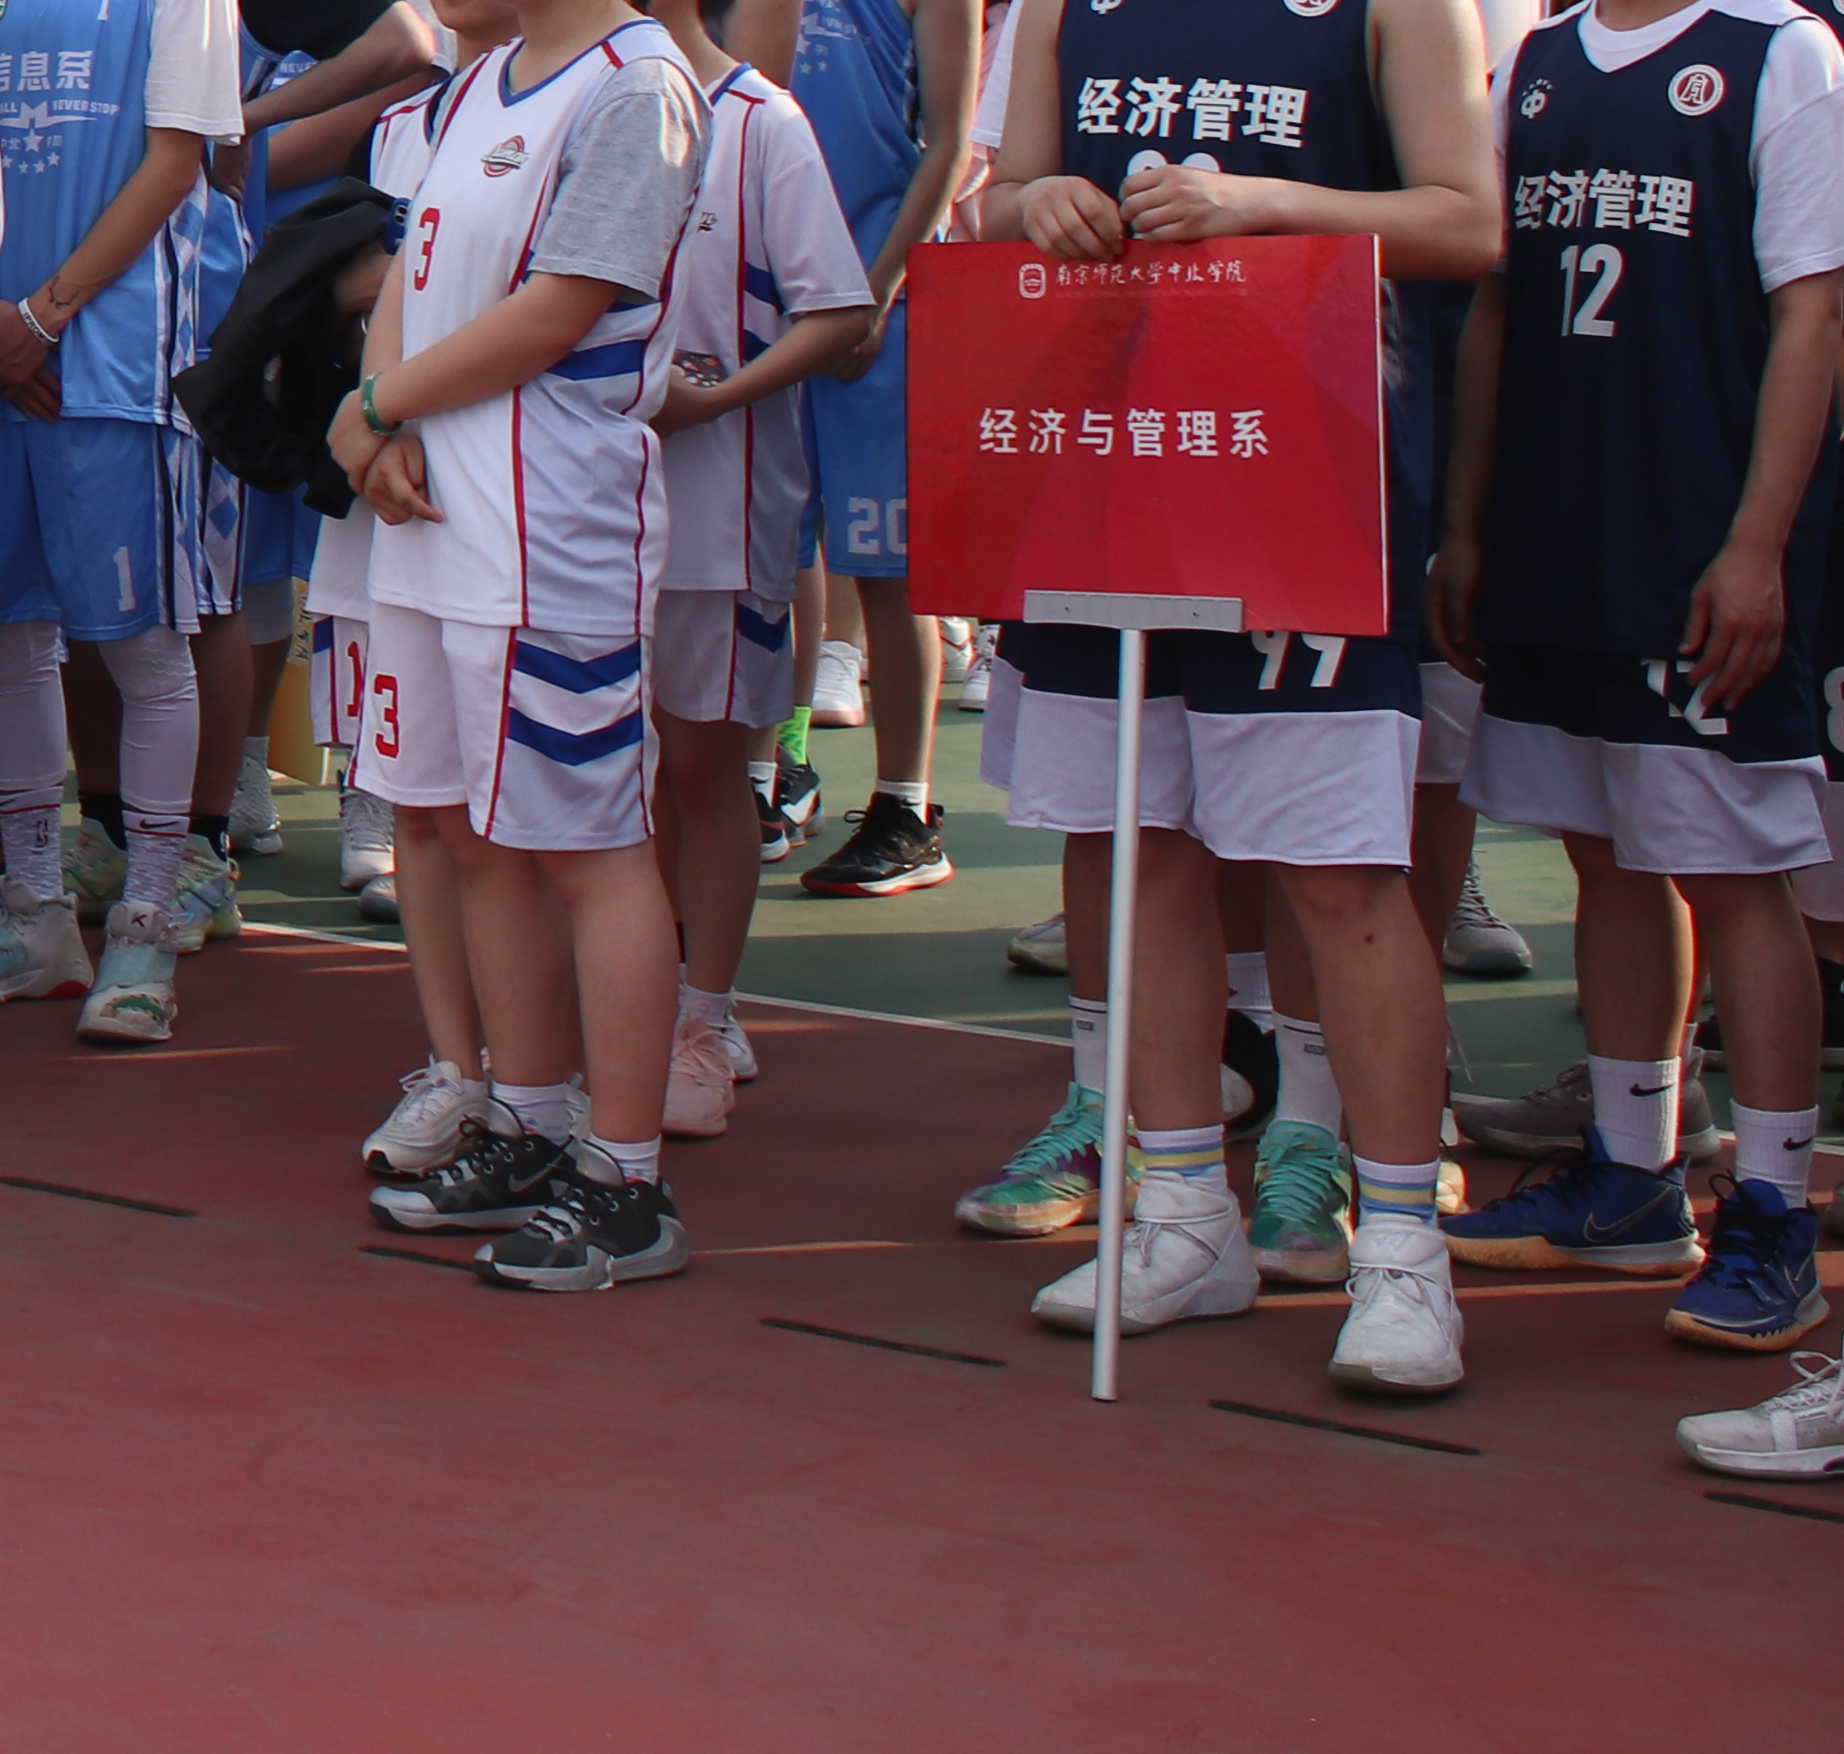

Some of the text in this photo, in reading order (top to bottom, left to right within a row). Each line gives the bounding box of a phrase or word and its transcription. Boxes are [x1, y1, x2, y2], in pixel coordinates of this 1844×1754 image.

[1075, 75, 1308, 149] 经济管理
[1514, 167, 1694, 240] 经济管理
[413, 207, 441, 292] 3
[1558, 243, 1623, 339] 12
[978, 406, 1269, 460] 经济与管理系
[117, 545, 135, 612] 1
[373, 673, 400, 759] 3
